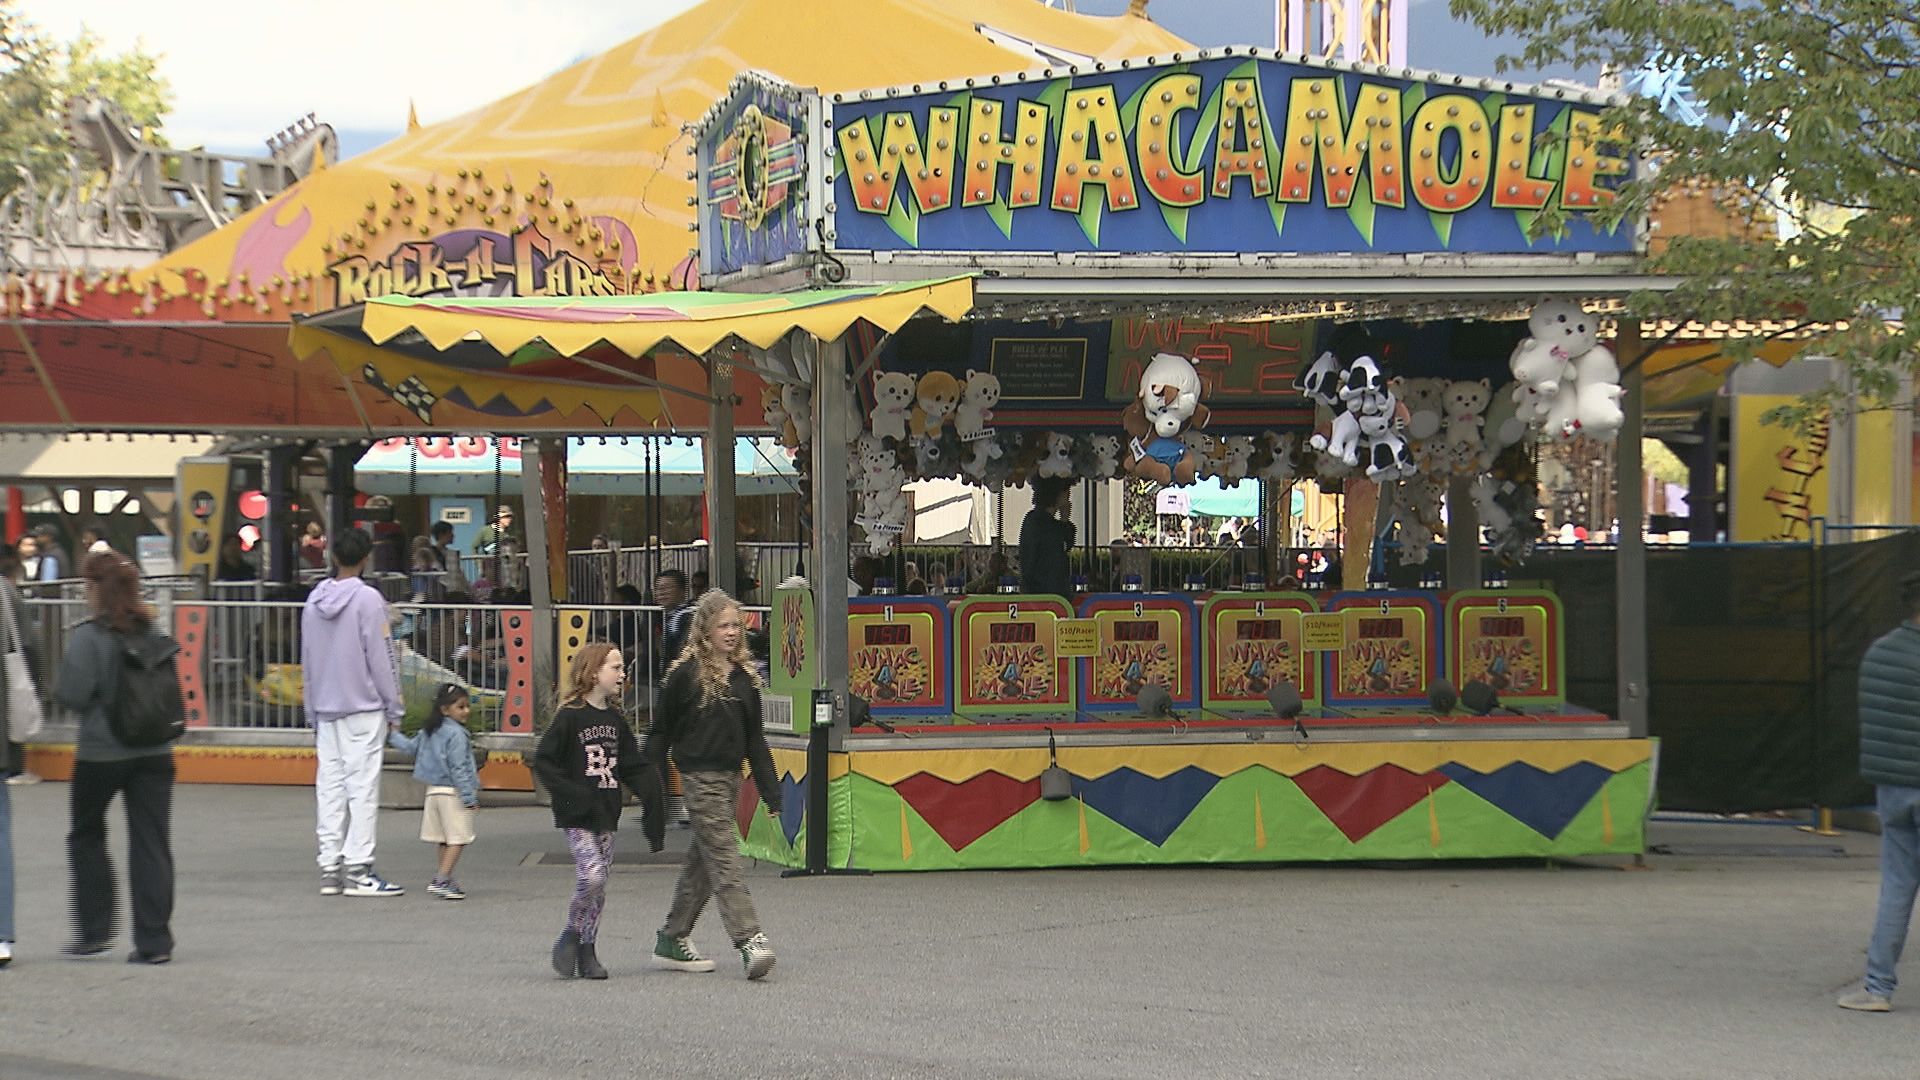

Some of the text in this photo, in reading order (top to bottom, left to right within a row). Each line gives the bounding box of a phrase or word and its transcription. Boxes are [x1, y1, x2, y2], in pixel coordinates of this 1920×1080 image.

[856, 646, 918, 669] WHAC
[982, 645, 1044, 668] WHAC
[853, 679, 923, 701] MOLE
[977, 677, 1049, 700] MOLE
